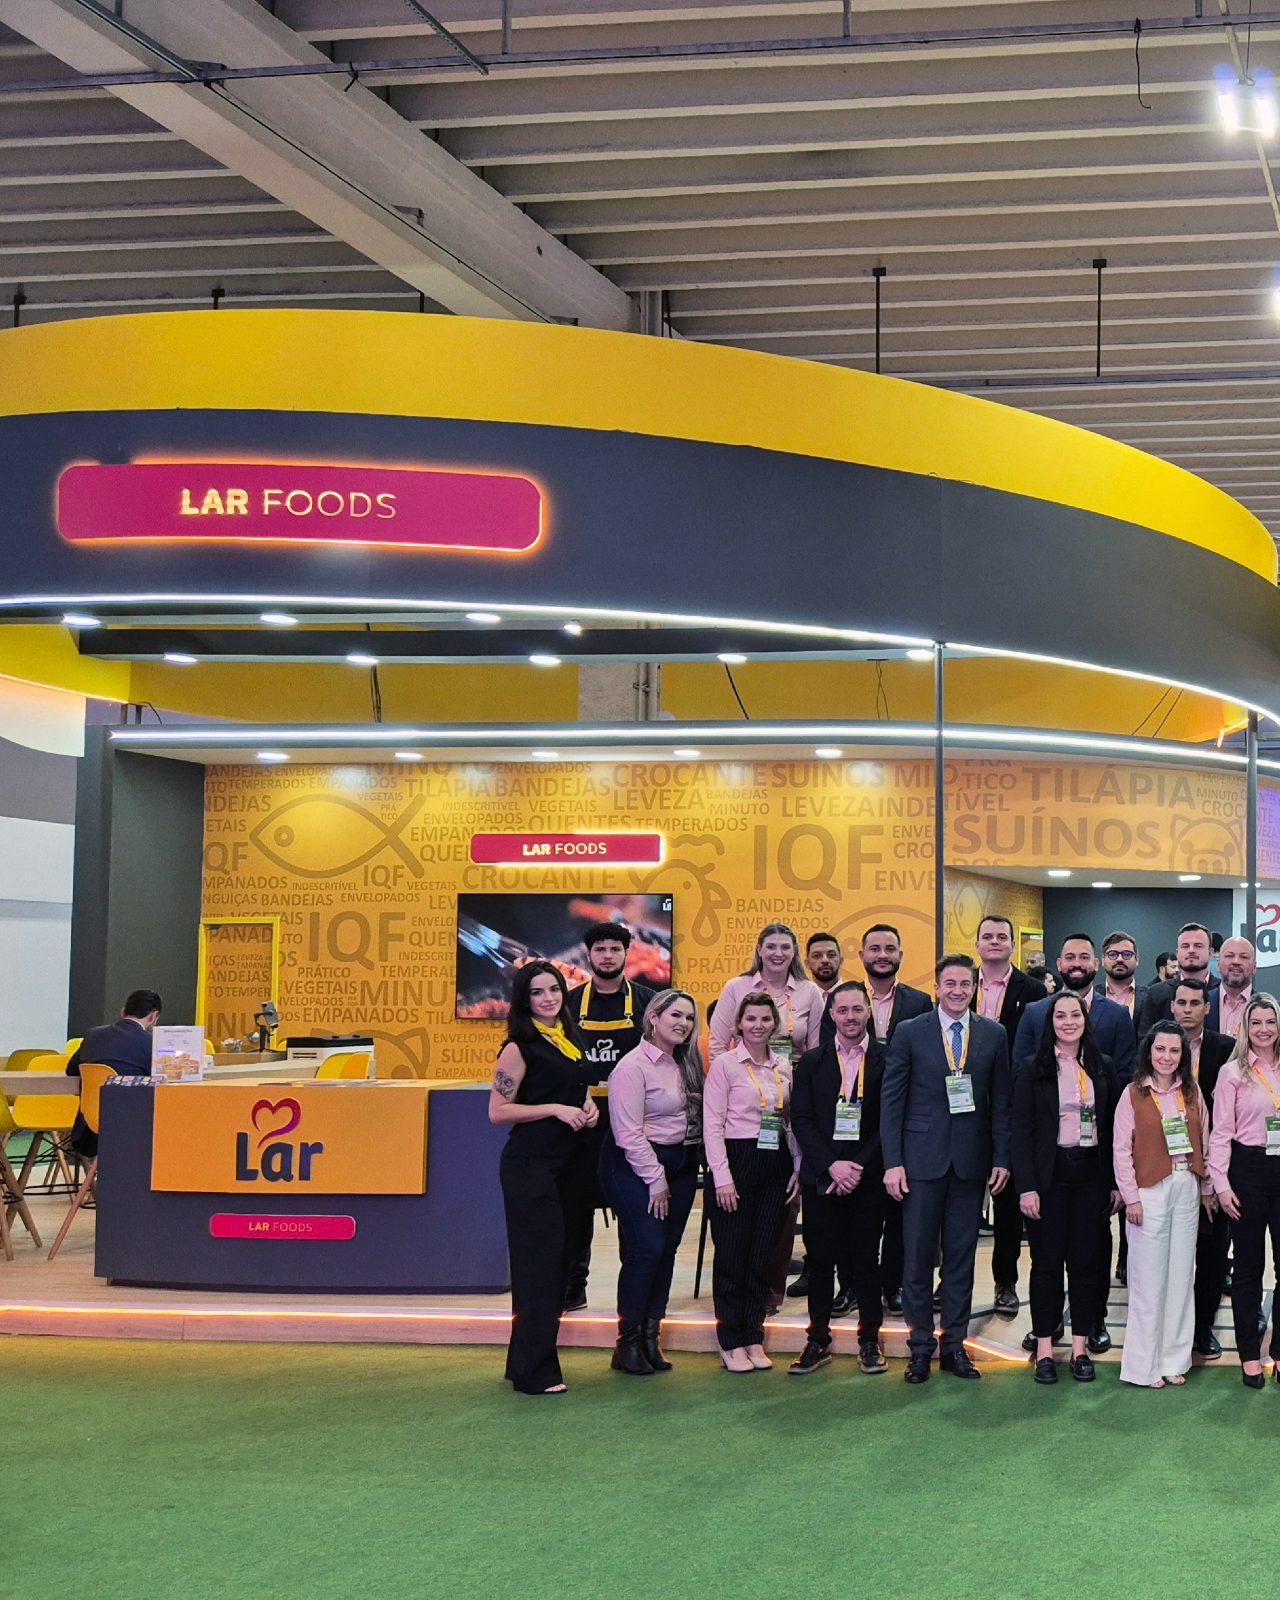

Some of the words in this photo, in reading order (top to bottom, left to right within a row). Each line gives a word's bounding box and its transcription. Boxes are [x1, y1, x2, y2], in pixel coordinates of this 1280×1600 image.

[180, 488, 249, 516] LAR
[262, 489, 397, 519] FOODS
[613, 763, 767, 787] CROCANTE
[229, 778, 306, 790] TEMPERADOS
[495, 777, 611, 797] BANDEJAS
[1021, 763, 1196, 810] TILÁPIA
[357, 792, 403, 801] VEGETAIS
[613, 788, 706, 811] LEVEZA
[706, 788, 768, 800] BANDEJAS
[1196, 787, 1239, 802] MINUTO
[528, 800, 597, 812] VEGETAIS
[709, 803, 770, 815] MINUTO
[781, 795, 872, 818] LEVEZA
[424, 813, 523, 825] ENVELOPADOS
[528, 815, 632, 833] QUENTES
[635, 818, 748, 832] TEMPERADOS
[952, 806, 1161, 860] SUÍNOS
[522, 843, 552, 856] LAR
[555, 842, 608, 856] FOODS
[754, 823, 885, 901] IQF
[363, 864, 405, 890] IQF
[462, 866, 617, 890] CROCANTE
[292, 880, 359, 891] INDESCRITÍVEL
[406, 880, 457, 891] VEGETAIS
[261, 893, 334, 907] BANDEJAS
[340, 893, 421, 903] ENVELOPADOS
[736, 898, 824, 913] BANDEJAS
[309, 910, 406, 971] IQF
[297, 964, 351, 978] PRÁTICO
[284, 980, 358, 994] VEGETAIS
[303, 1007, 419, 1024] EMPANADOS
[591, 1049, 620, 1063] Lar
[235, 1131, 324, 1183] Lar
[248, 1221, 270, 1232] LAR
[272, 1222, 313, 1233] FOODS
